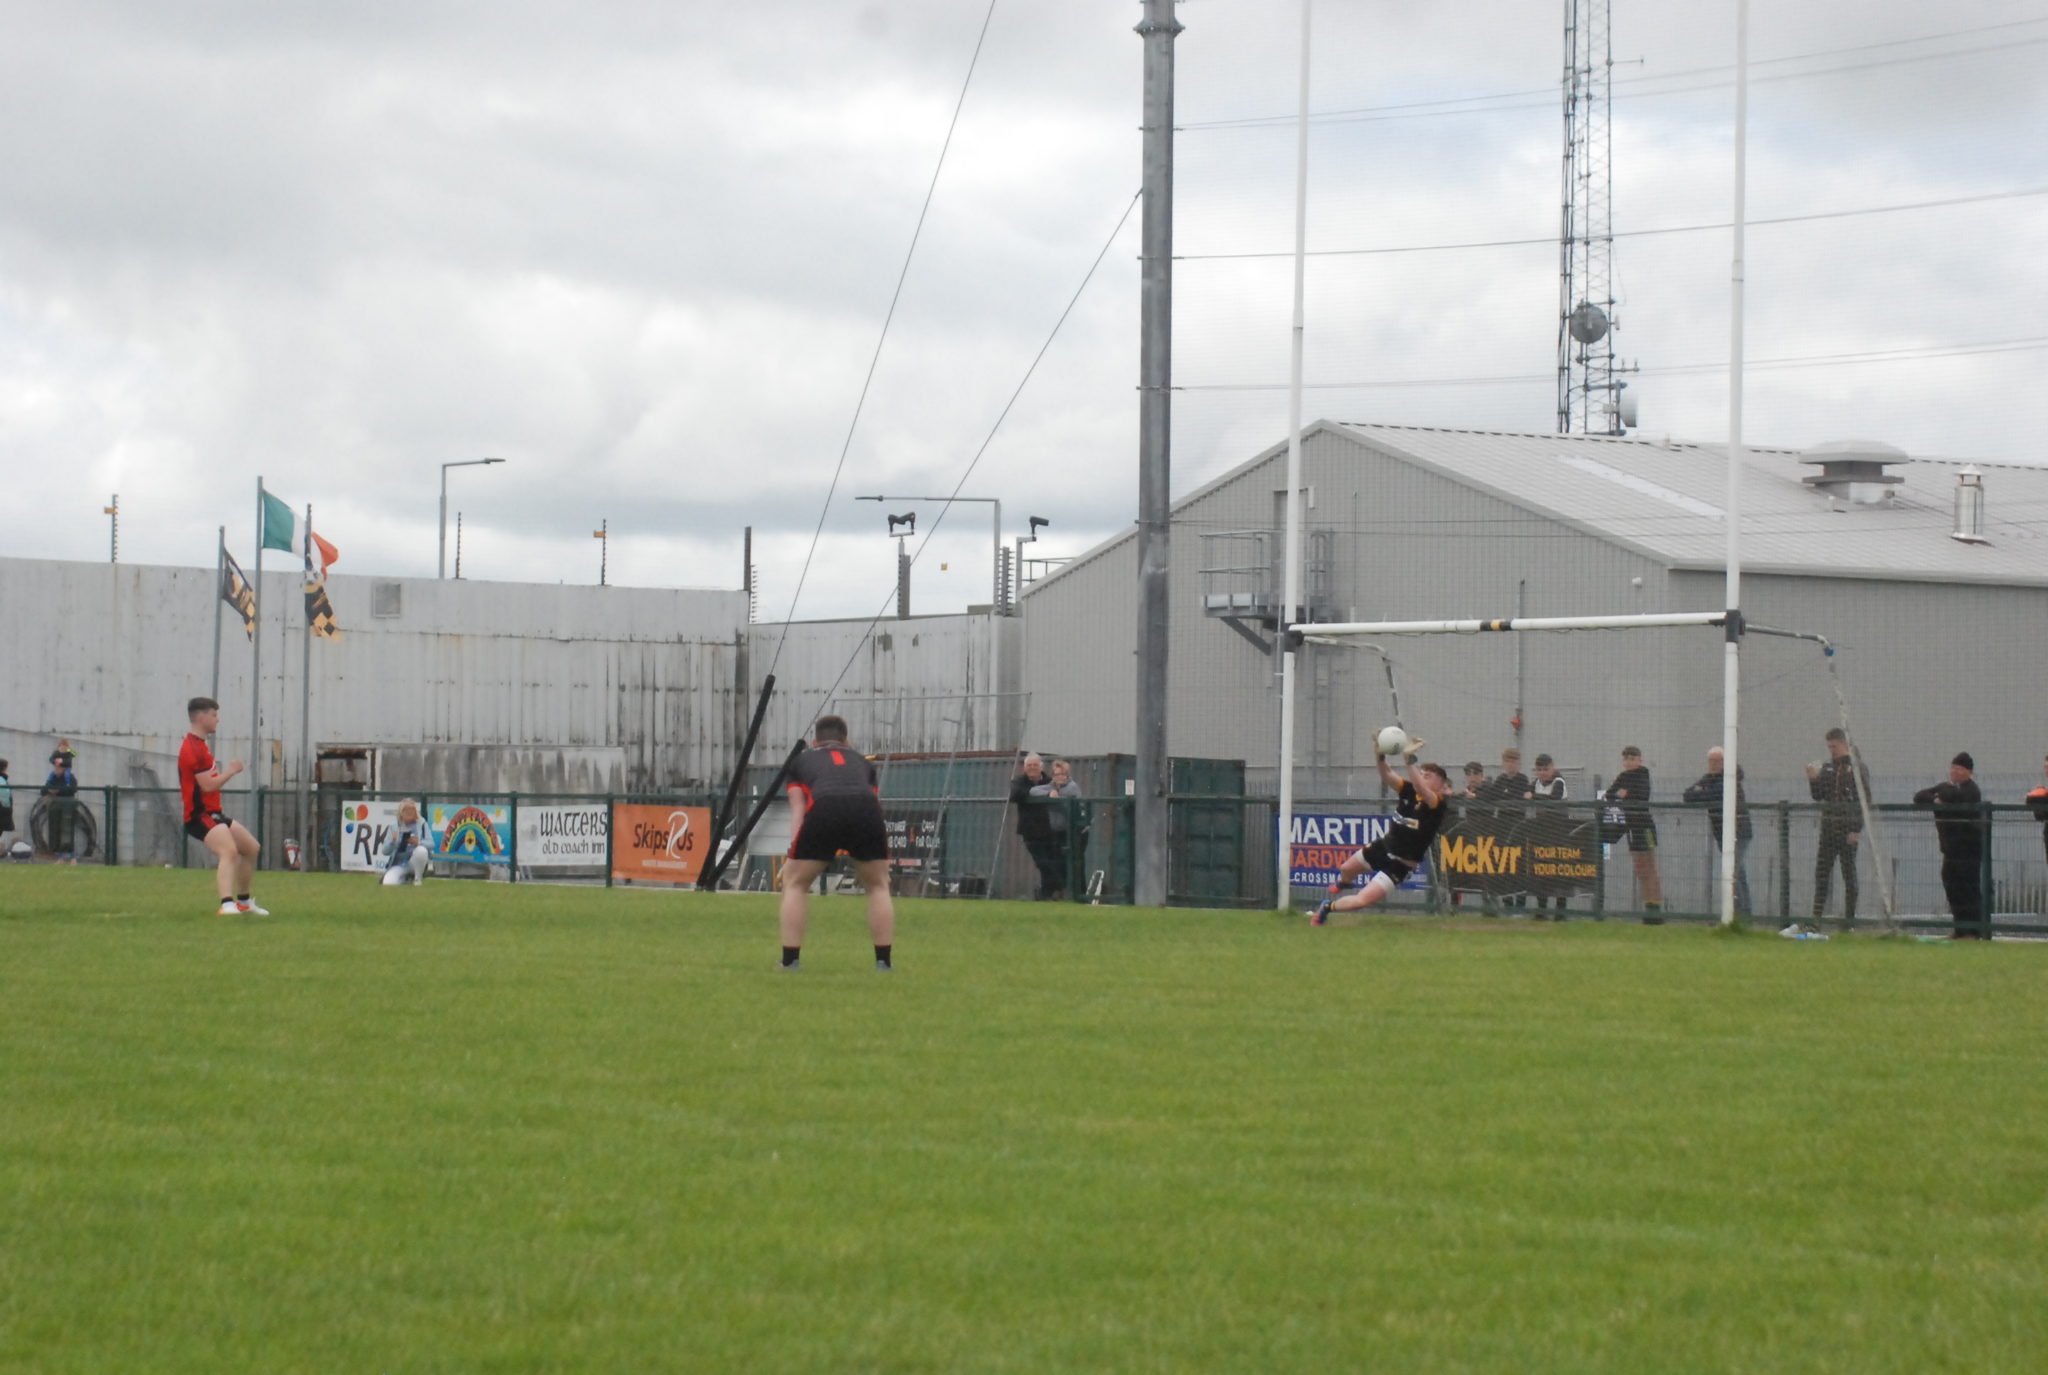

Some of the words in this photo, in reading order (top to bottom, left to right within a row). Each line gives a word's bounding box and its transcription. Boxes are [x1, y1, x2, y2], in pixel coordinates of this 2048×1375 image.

[540, 811, 608, 837] WATTERS
[633, 822, 669, 856] Skips
[1534, 847, 1556, 858] YOUR
[1557, 847, 1581, 859] TEAM
[1534, 863, 1556, 875] YOUR
